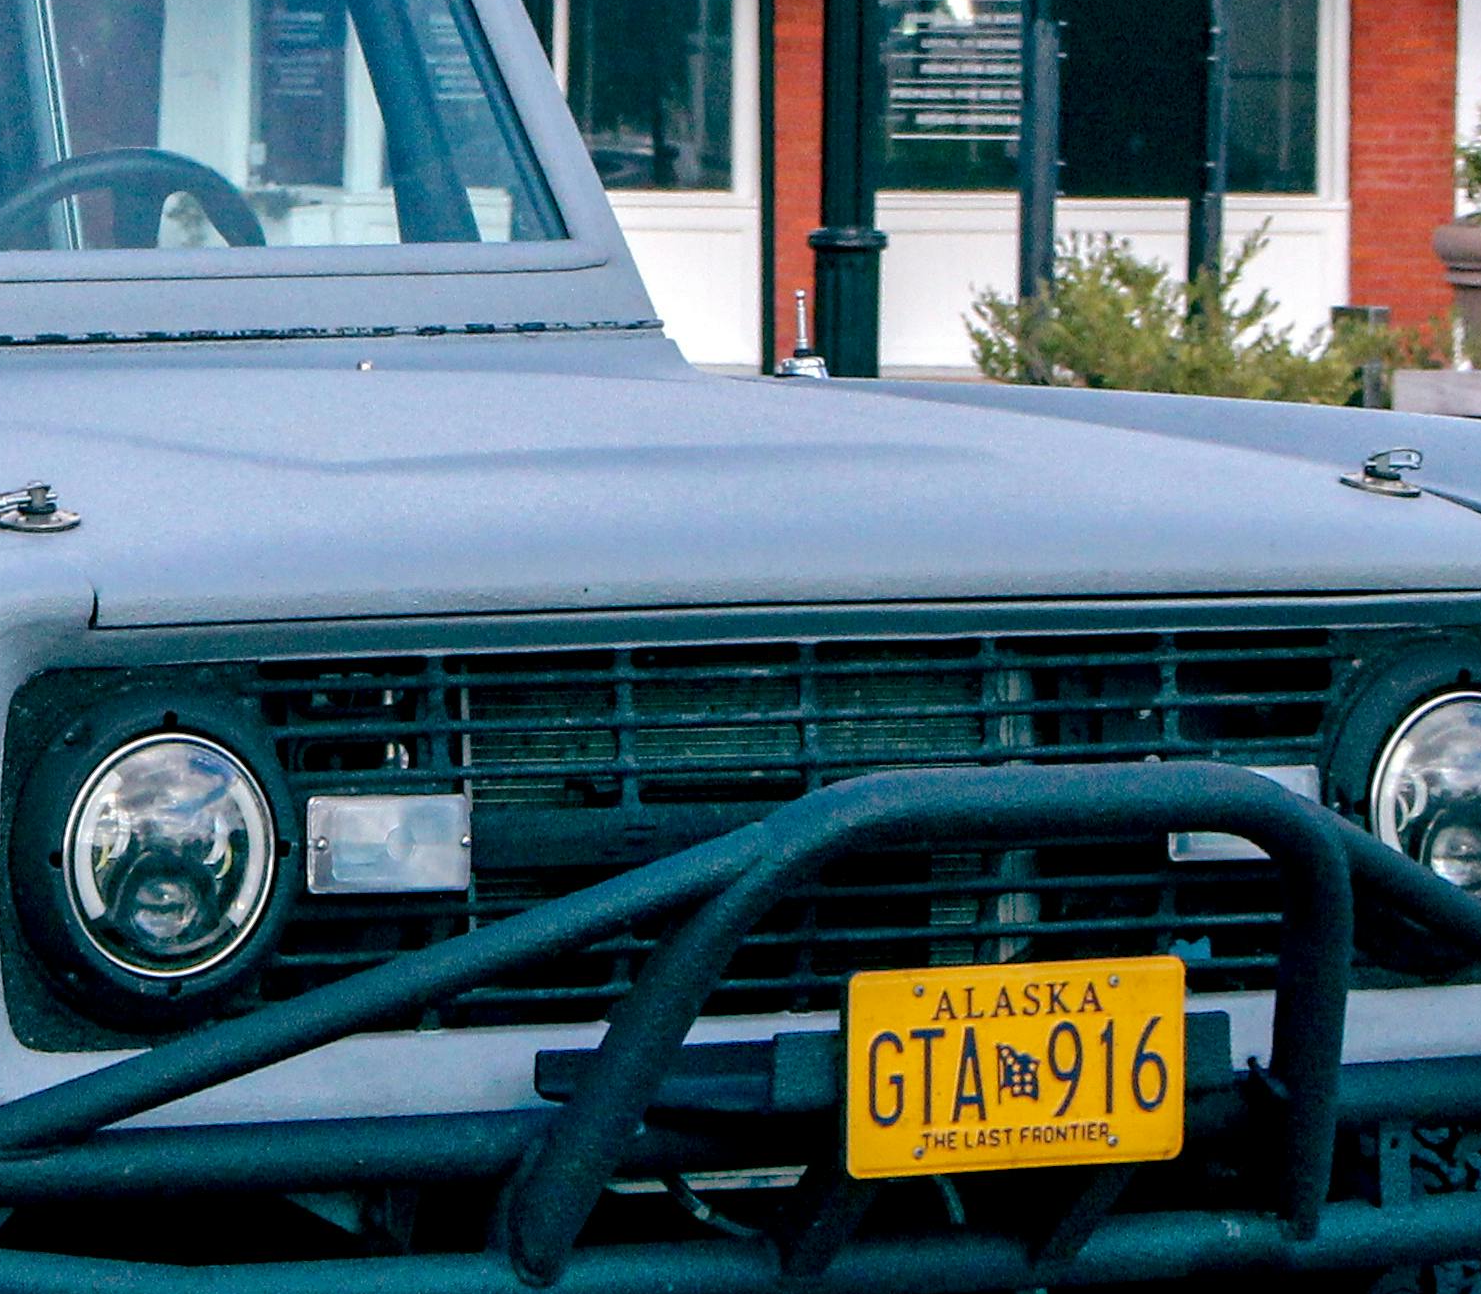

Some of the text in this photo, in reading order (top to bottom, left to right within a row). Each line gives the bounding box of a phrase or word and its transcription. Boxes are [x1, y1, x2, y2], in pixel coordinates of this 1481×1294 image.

[932, 981, 1104, 1021] ALASKA
[868, 1016, 1168, 1128] GTA 916
[922, 1122, 1110, 1150] THE LAST FRONTIER
